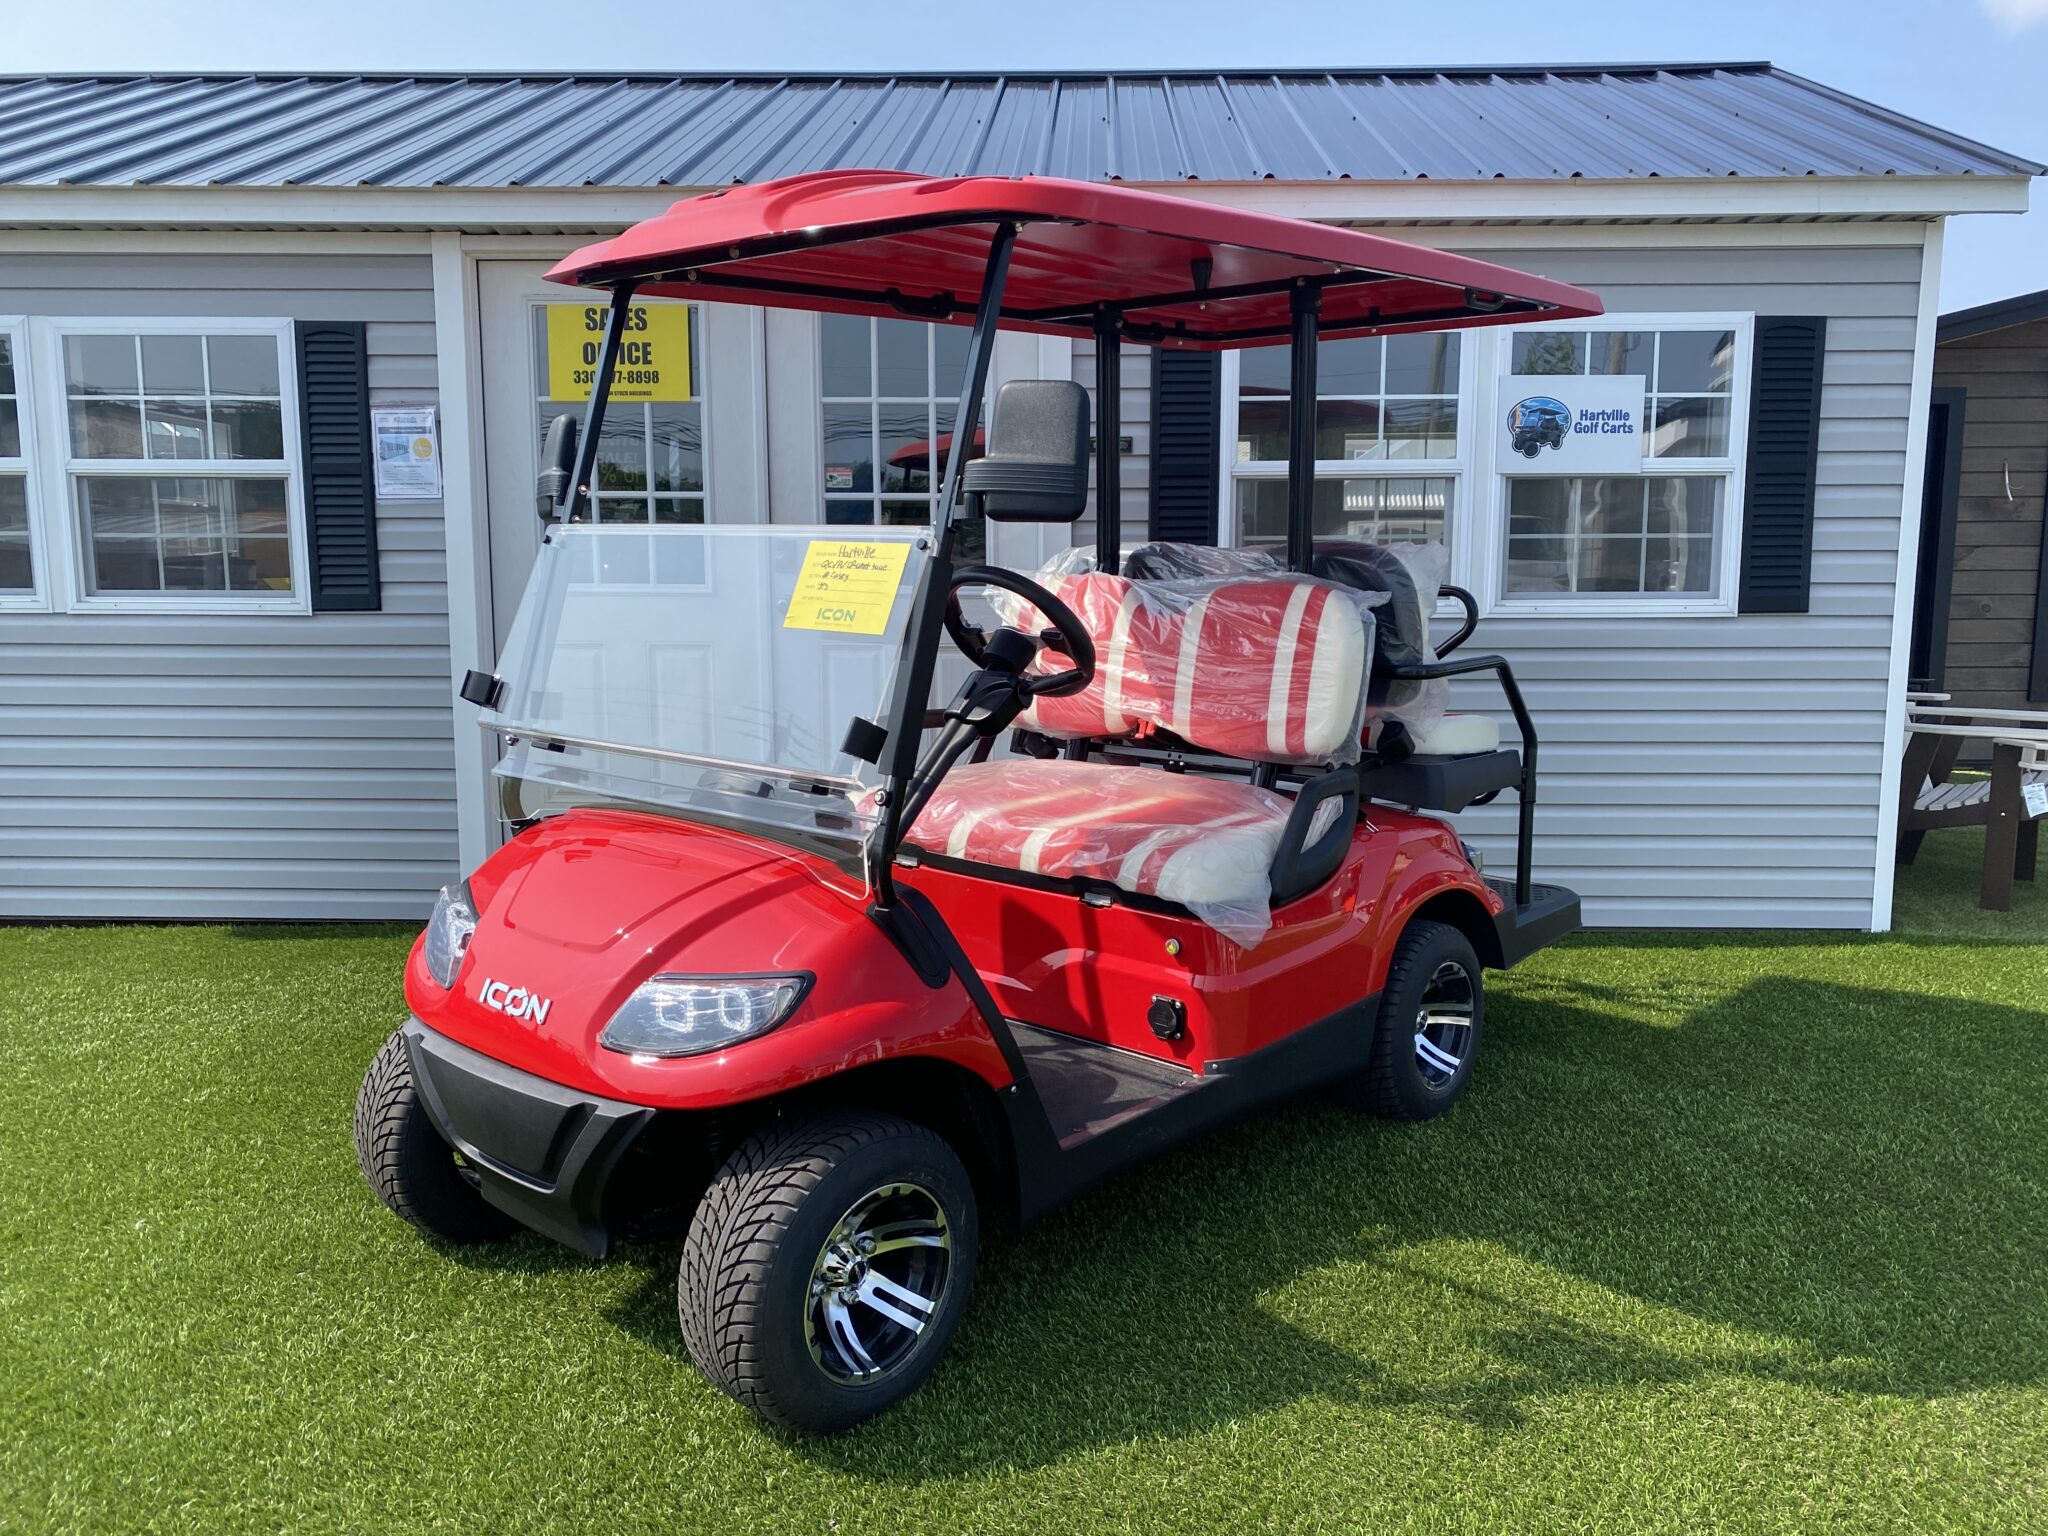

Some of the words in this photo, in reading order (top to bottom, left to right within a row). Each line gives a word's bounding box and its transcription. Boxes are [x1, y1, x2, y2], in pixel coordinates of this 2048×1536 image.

[582, 341, 653, 365] OICE
[1579, 409, 1630, 421] Hartville
[1574, 422, 1599, 434] Golf
[1601, 422, 1634, 434] Carts
[816, 607, 857, 623] ICON
[478, 977, 552, 1025] ICON
